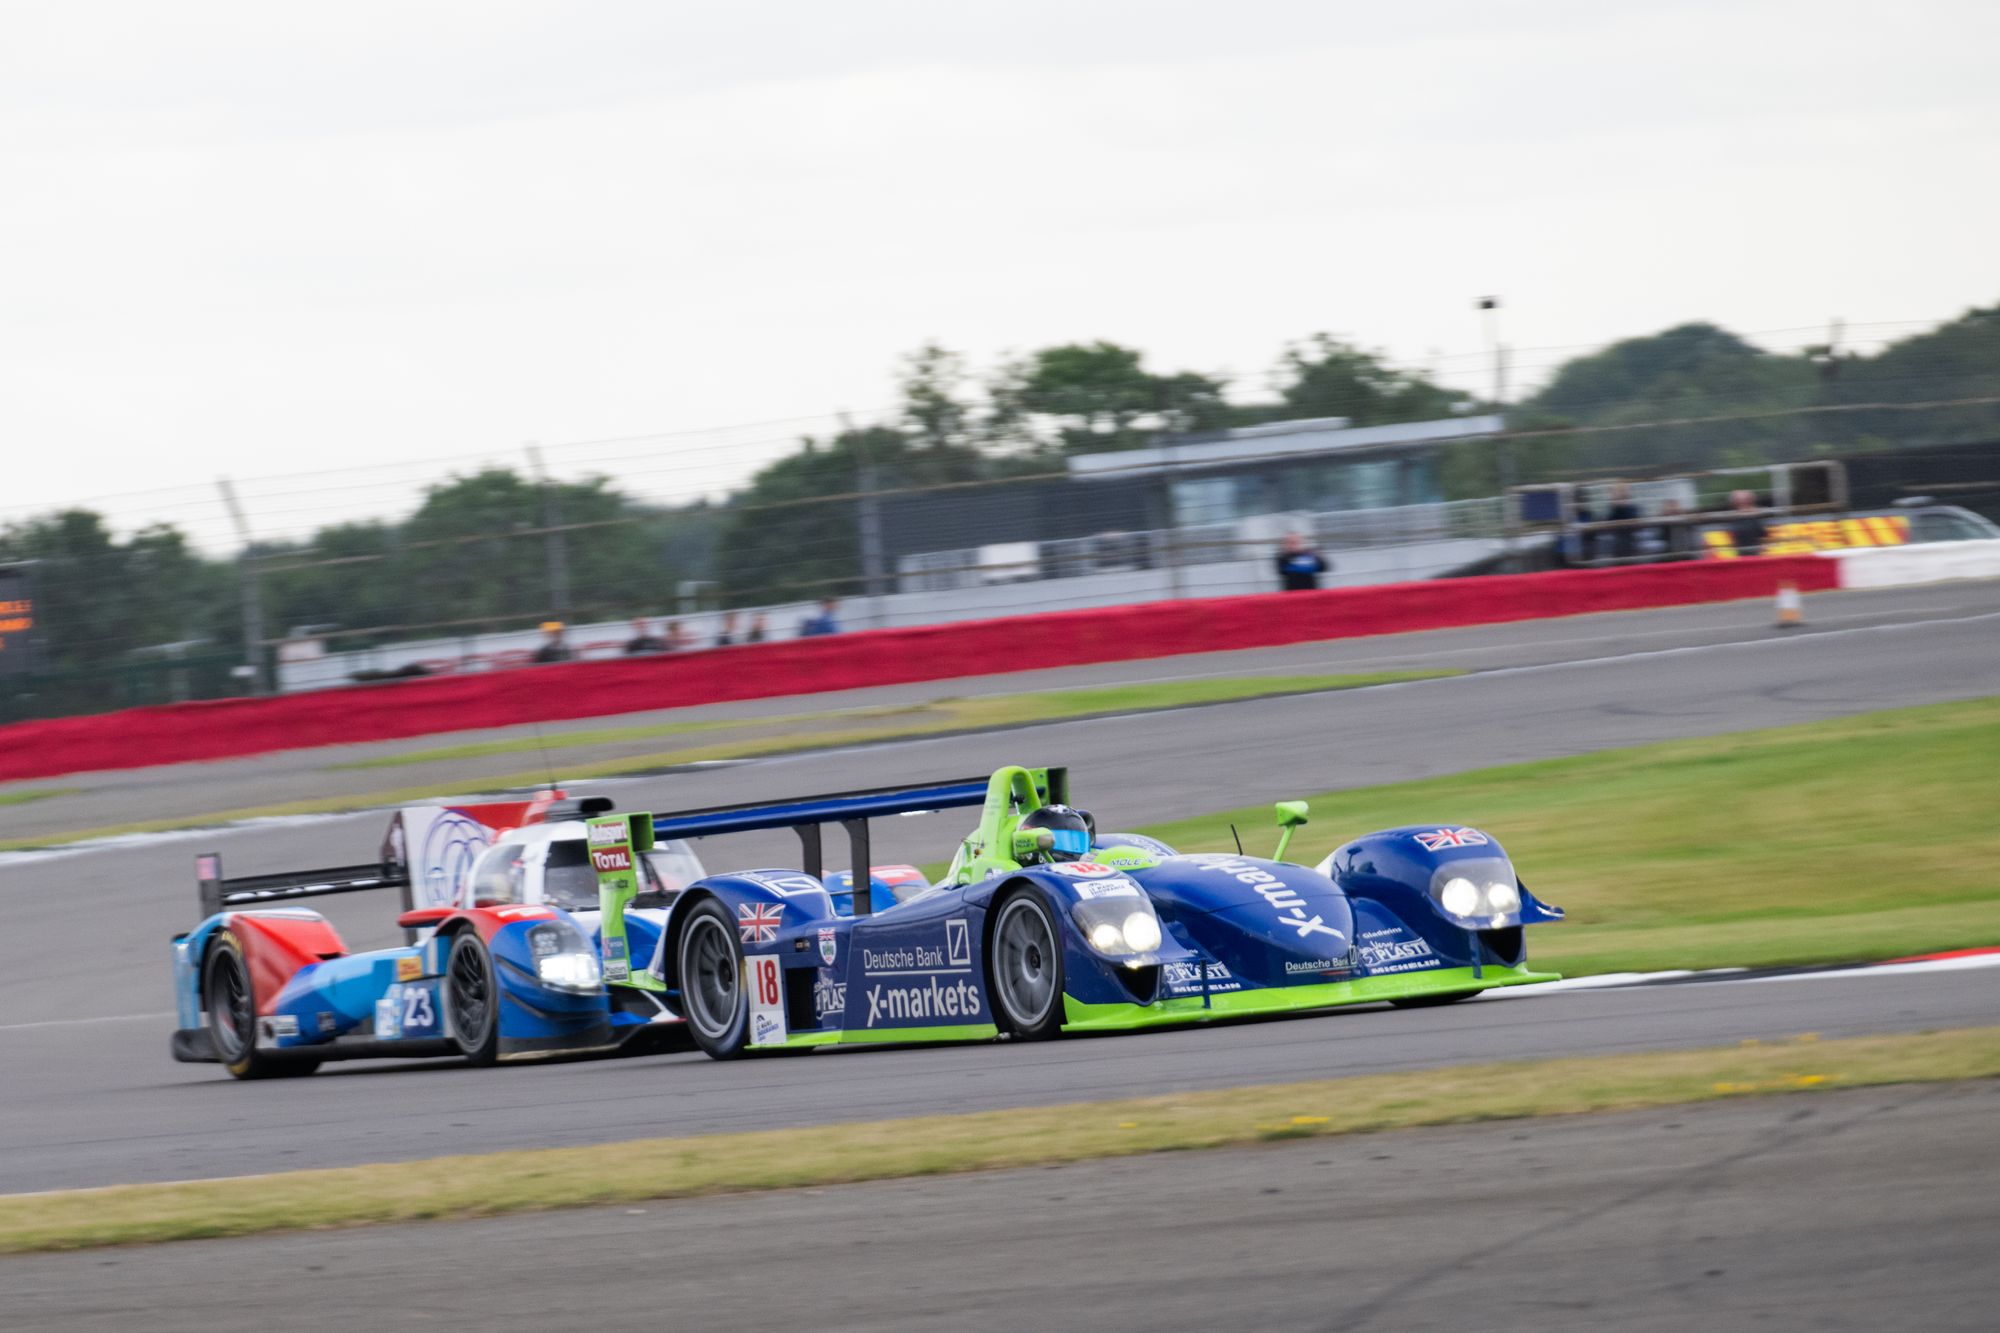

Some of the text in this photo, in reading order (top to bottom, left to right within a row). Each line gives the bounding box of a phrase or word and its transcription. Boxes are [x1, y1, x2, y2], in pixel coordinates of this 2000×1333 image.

[592, 851, 630, 868] TOTAL
[1362, 927, 1403, 939] Gladwins
[863, 945, 944, 969] Deutsche Bank
[1285, 959, 1331, 971] Deutsche
[1371, 958, 1441, 974] MICHELIN
[756, 960, 779, 1005] 18
[403, 987, 434, 1027] 23
